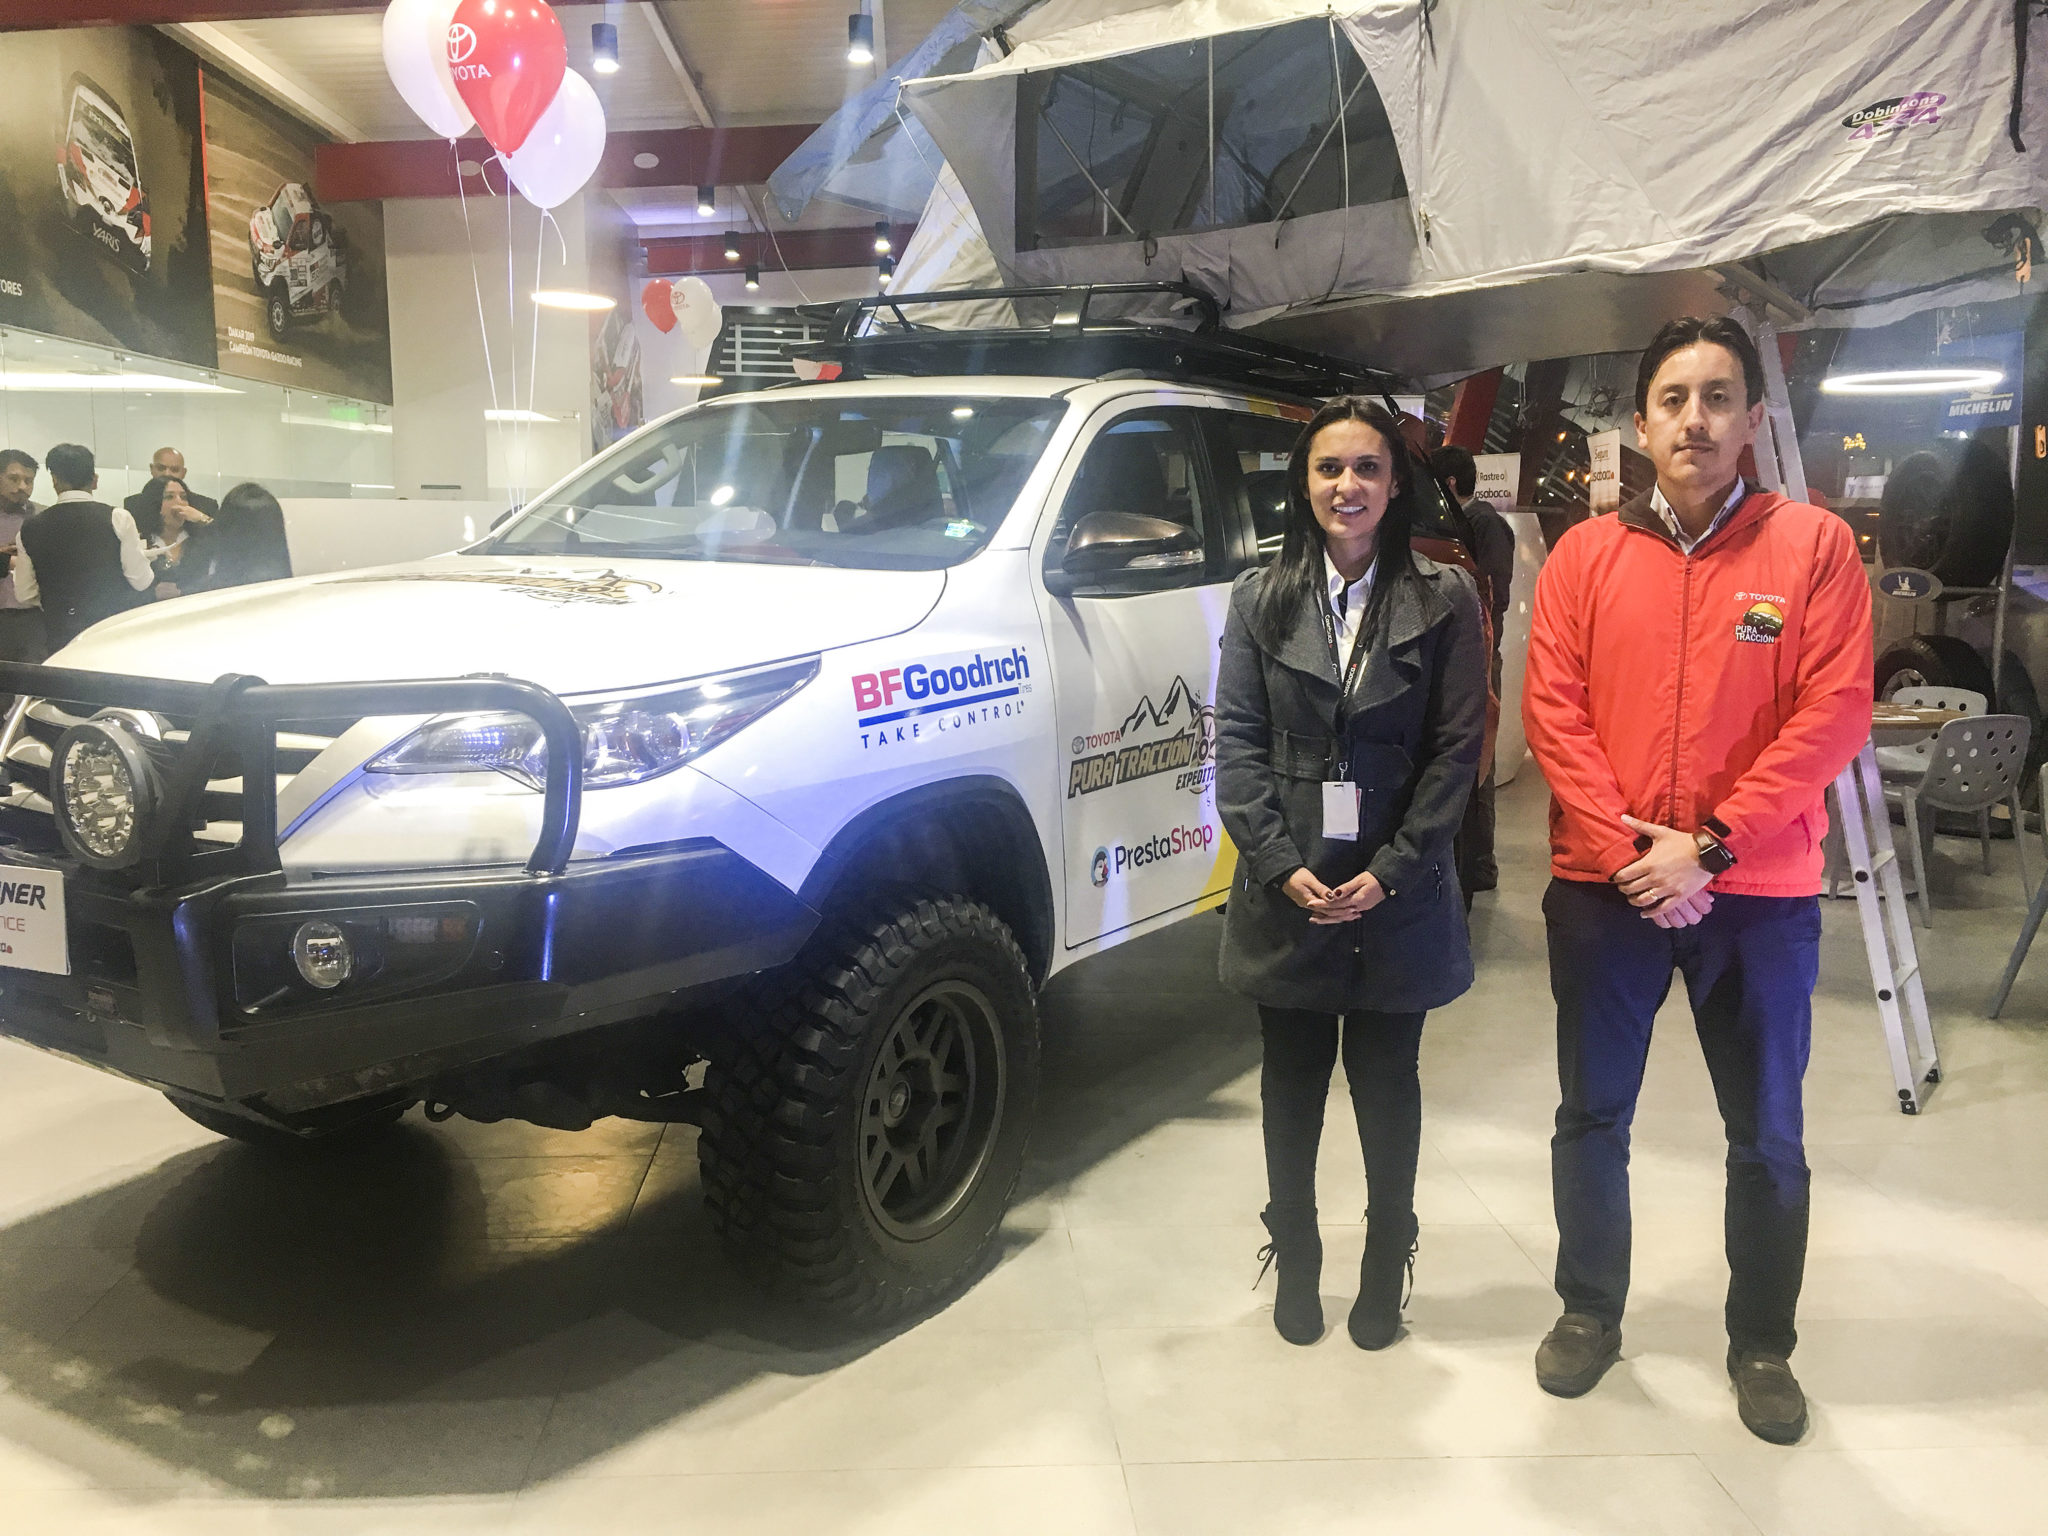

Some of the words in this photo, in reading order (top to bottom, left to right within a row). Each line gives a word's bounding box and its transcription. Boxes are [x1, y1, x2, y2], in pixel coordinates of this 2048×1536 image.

[450, 63, 493, 81] YOTA
[0, 279, 22, 296] ORES
[1948, 399, 2013, 417] MICHELIN
[1749, 592, 1786, 604] TOYOTA
[1735, 624, 1758, 635] PURA
[1735, 632, 1775, 643] TRACCIÓN
[852, 648, 1030, 712] BFGoodrich
[861, 723, 920, 749] TAKE
[938, 701, 1022, 732] CONTROL
[1085, 729, 1121, 750] TOYOTA
[1068, 750, 1117, 799] PURA
[1116, 726, 1196, 784] TRACCIÓN
[1175, 766, 1216, 791] EXPEDITI
[1115, 824, 1213, 874] PrestaShop
[0, 881, 46, 911] NER
